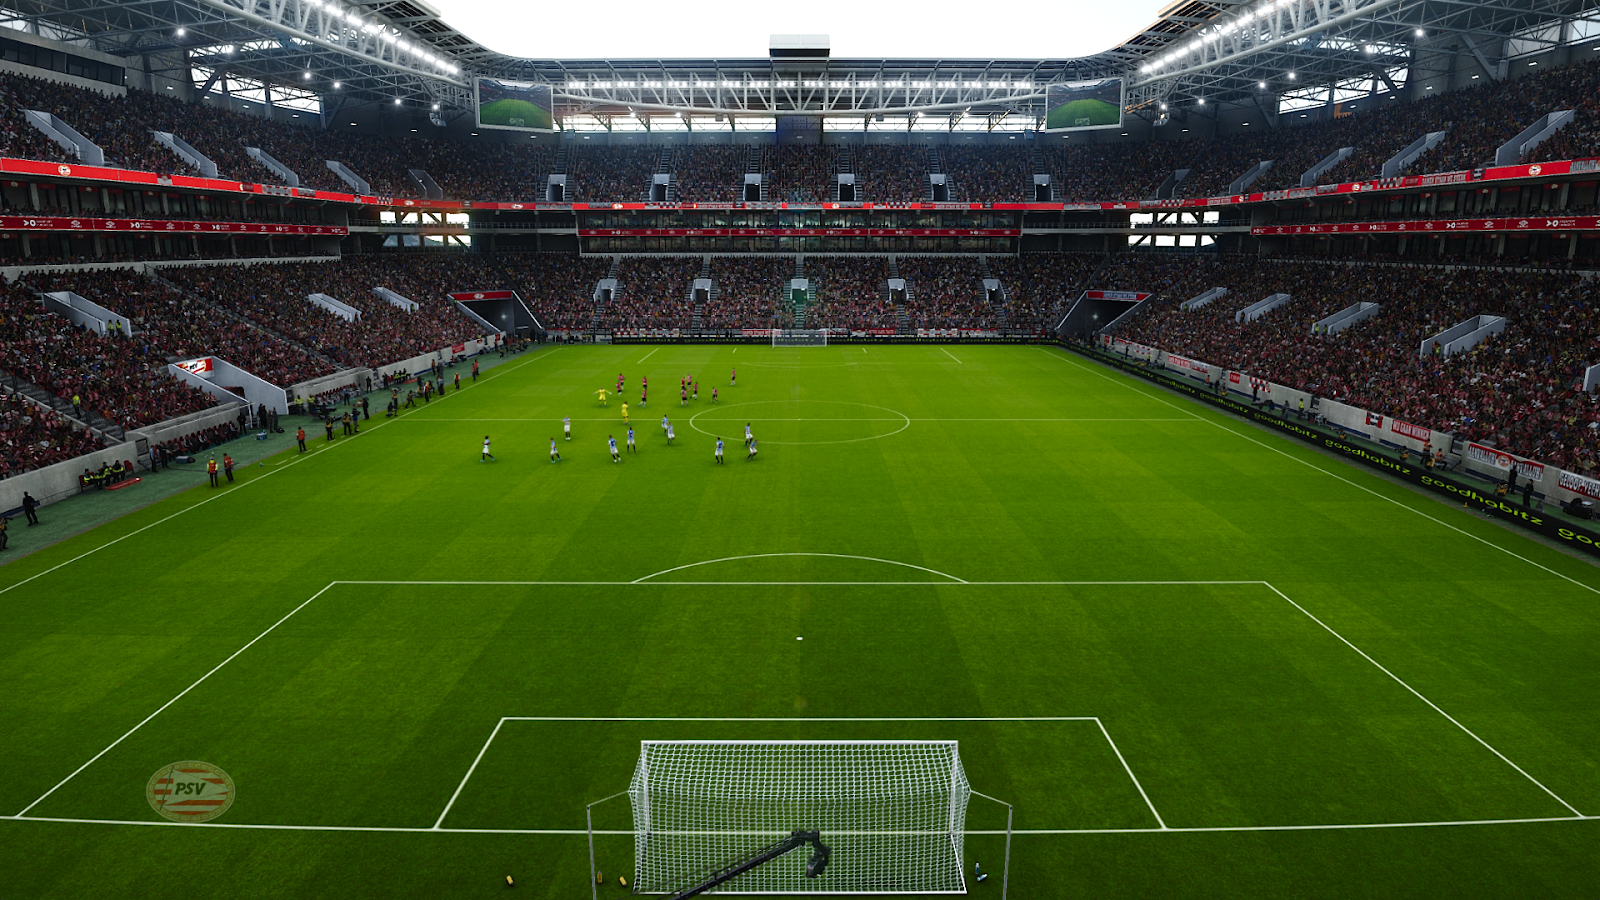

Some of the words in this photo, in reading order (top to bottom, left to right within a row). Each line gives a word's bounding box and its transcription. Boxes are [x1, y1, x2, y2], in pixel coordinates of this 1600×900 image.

[1254, 412, 1318, 439] goodhabitz
[1325, 439, 1411, 475] goodhabitz
[1421, 475, 1543, 525] goodhabitz
[175, 782, 206, 796] PSV
